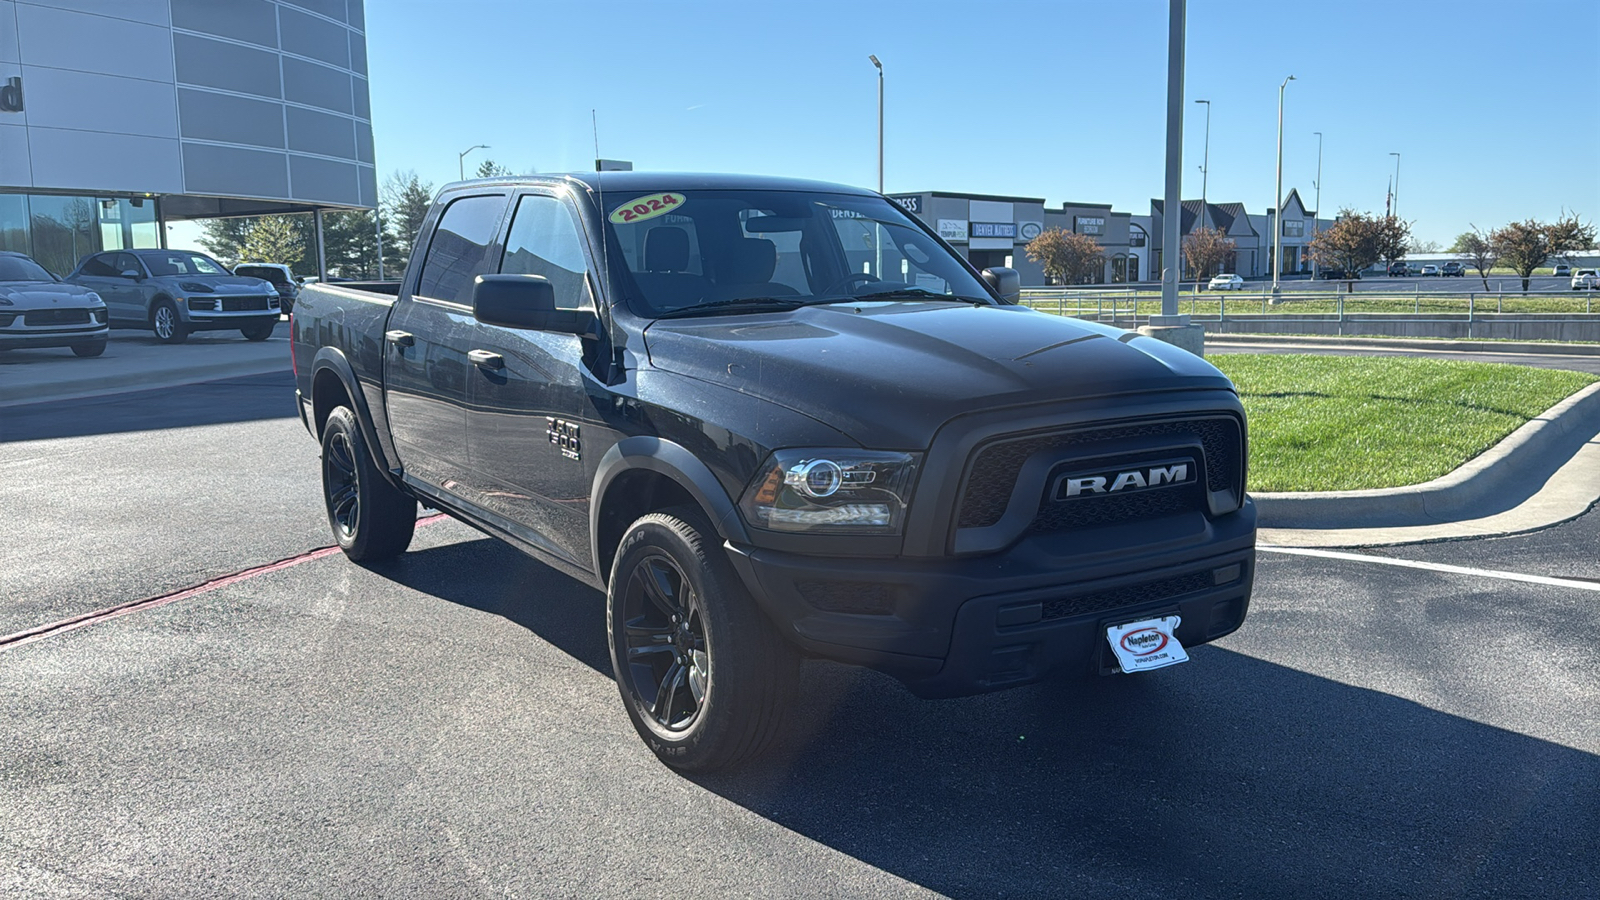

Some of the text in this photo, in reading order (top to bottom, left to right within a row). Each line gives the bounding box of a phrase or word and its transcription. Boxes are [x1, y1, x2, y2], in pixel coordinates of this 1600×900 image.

[618, 194, 679, 222] 2024
[975, 223, 993, 236] DENVER
[994, 224, 1014, 236] MATTRESS
[1066, 463, 1188, 498] RAM
[1127, 632, 1160, 648] Napleton
